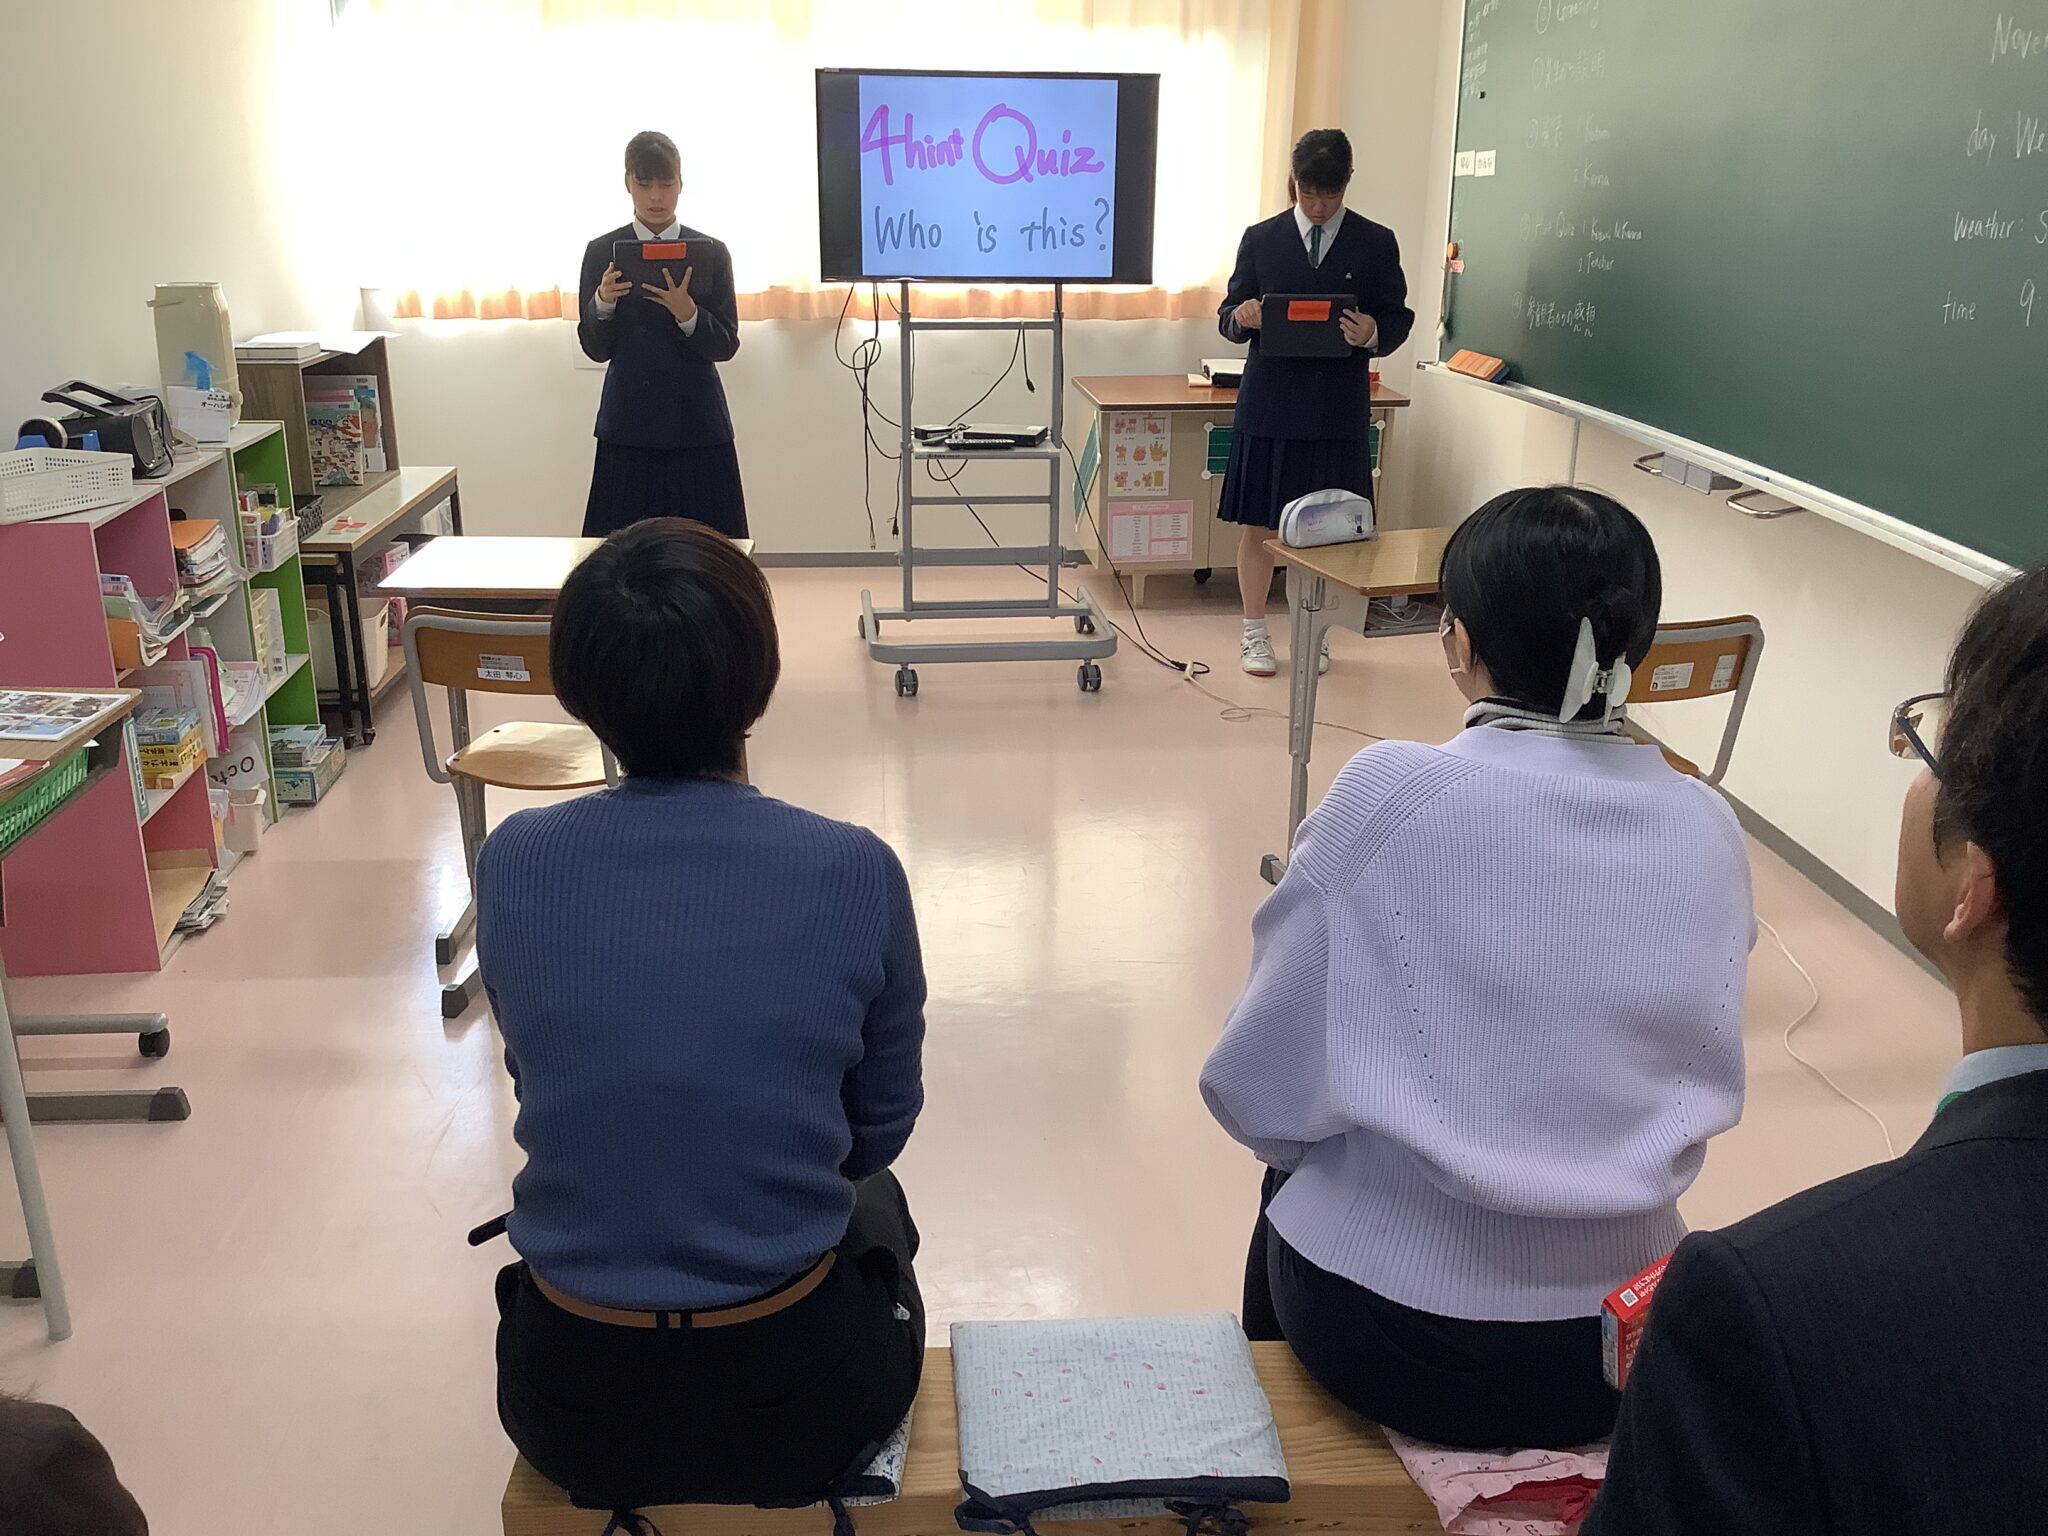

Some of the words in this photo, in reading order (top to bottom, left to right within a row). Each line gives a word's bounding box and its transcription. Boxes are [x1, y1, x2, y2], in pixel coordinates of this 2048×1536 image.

[1991, 12, 2048, 65] Nove
[973, 103, 1105, 185] Quiz
[1967, 109, 1997, 167] day
[874, 205, 942, 255] Who
[974, 210, 998, 254] is
[1019, 197, 1110, 252] this?
[1942, 290, 1977, 325] time
